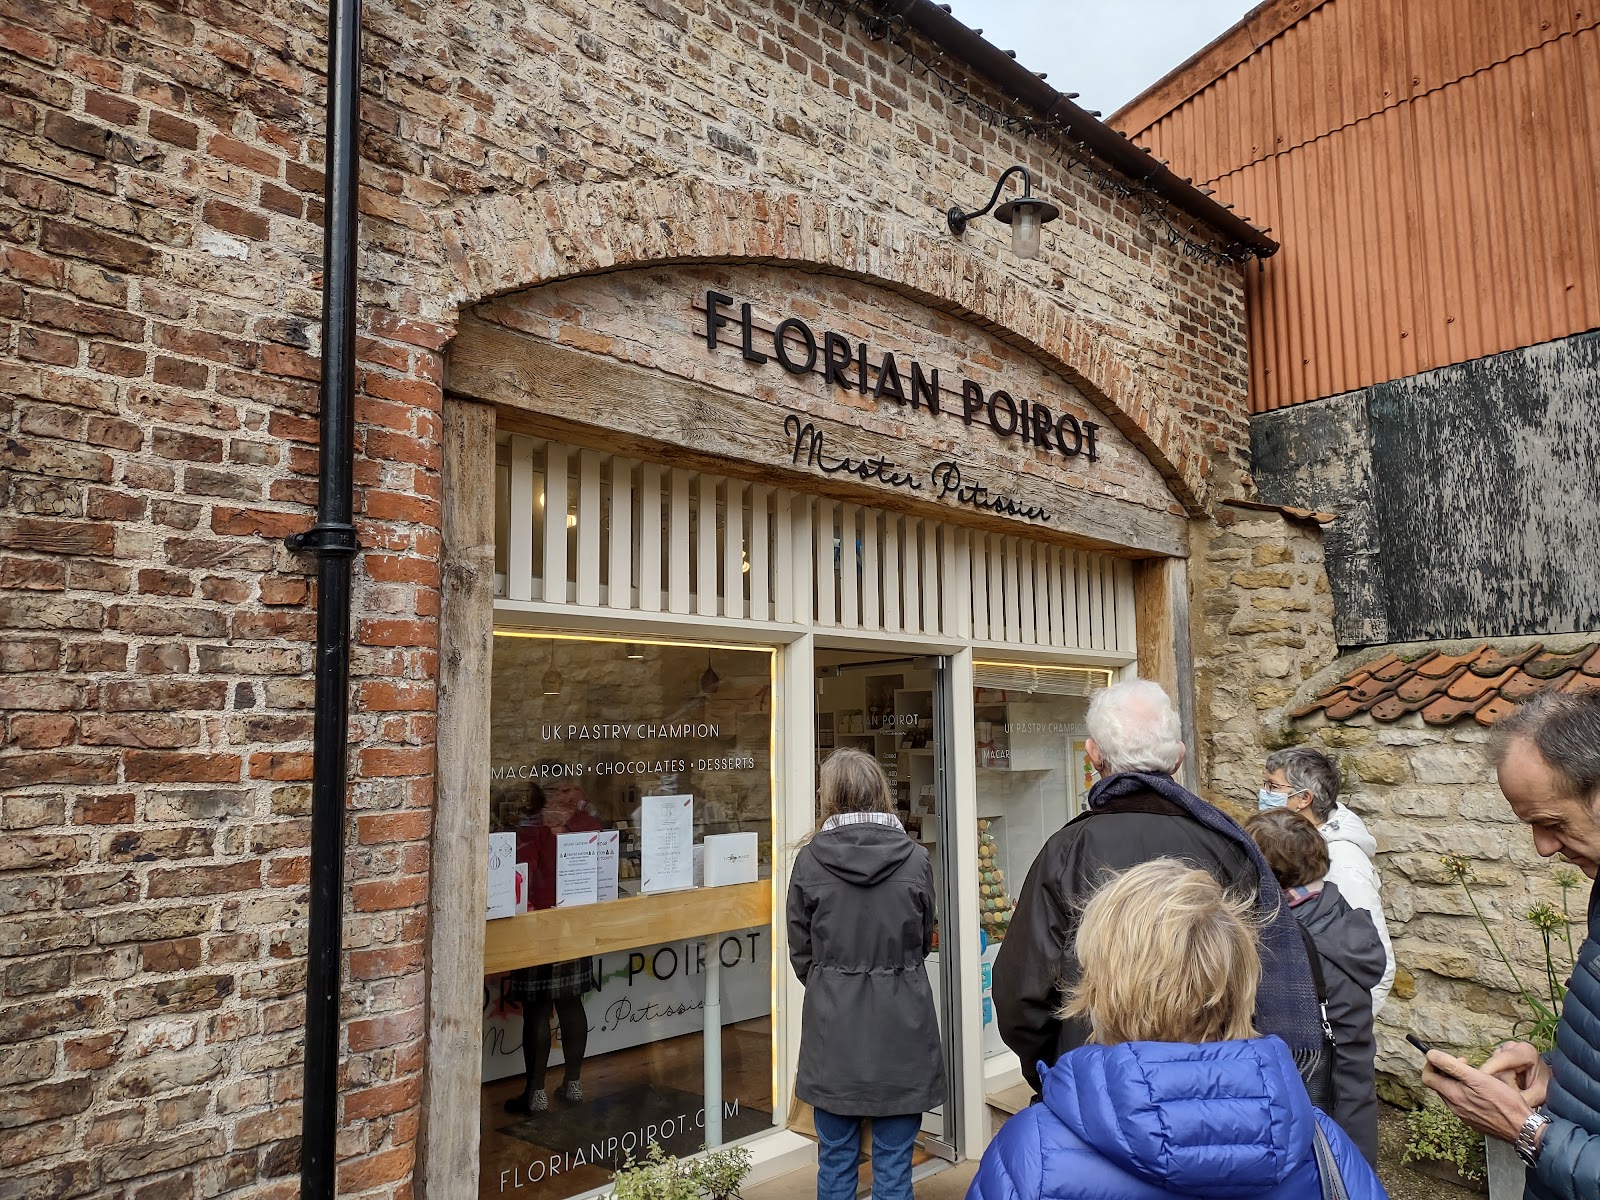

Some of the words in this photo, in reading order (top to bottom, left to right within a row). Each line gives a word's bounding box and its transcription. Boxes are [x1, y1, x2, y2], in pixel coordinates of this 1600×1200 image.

[706, 290, 940, 415] FLORIAN
[962, 379, 1100, 463] POIROT
[783, 414, 922, 489] Master
[931, 460, 1052, 522] Patissier
[541, 724, 562, 740] UK
[567, 724, 632, 740] PASTRY
[637, 723, 720, 740] CHAMPION
[882, 713, 919, 726] POIROT
[1004, 723, 1014, 734] UK
[1016, 723, 1046, 734] PASTRY
[490, 763, 584, 781] MACARONS
[595, 759, 686, 776] CHOCOLATES
[697, 757, 755, 771] DESSERTS
[629, 932, 760, 987] POIROT
[605, 996, 704, 1032] Patissie
